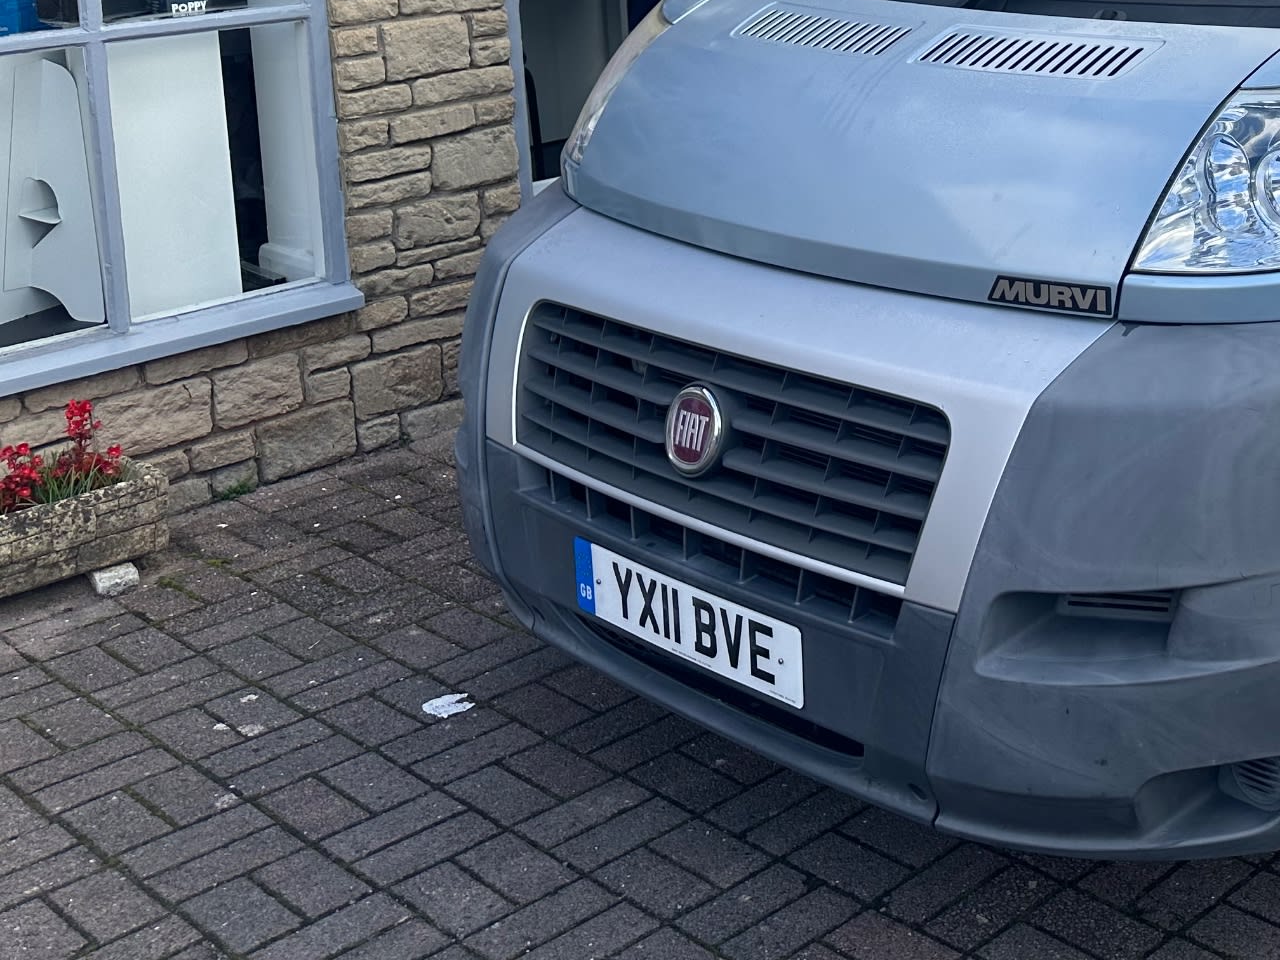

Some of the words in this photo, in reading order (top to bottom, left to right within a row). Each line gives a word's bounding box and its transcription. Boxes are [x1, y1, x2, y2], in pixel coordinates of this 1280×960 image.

[171, 0, 208, 14] POPPY
[992, 279, 1107, 312] MURVI
[675, 409, 710, 452] FIAT
[580, 583, 593, 600] GB
[612, 561, 682, 645] YX11
[692, 596, 776, 686] BVE
